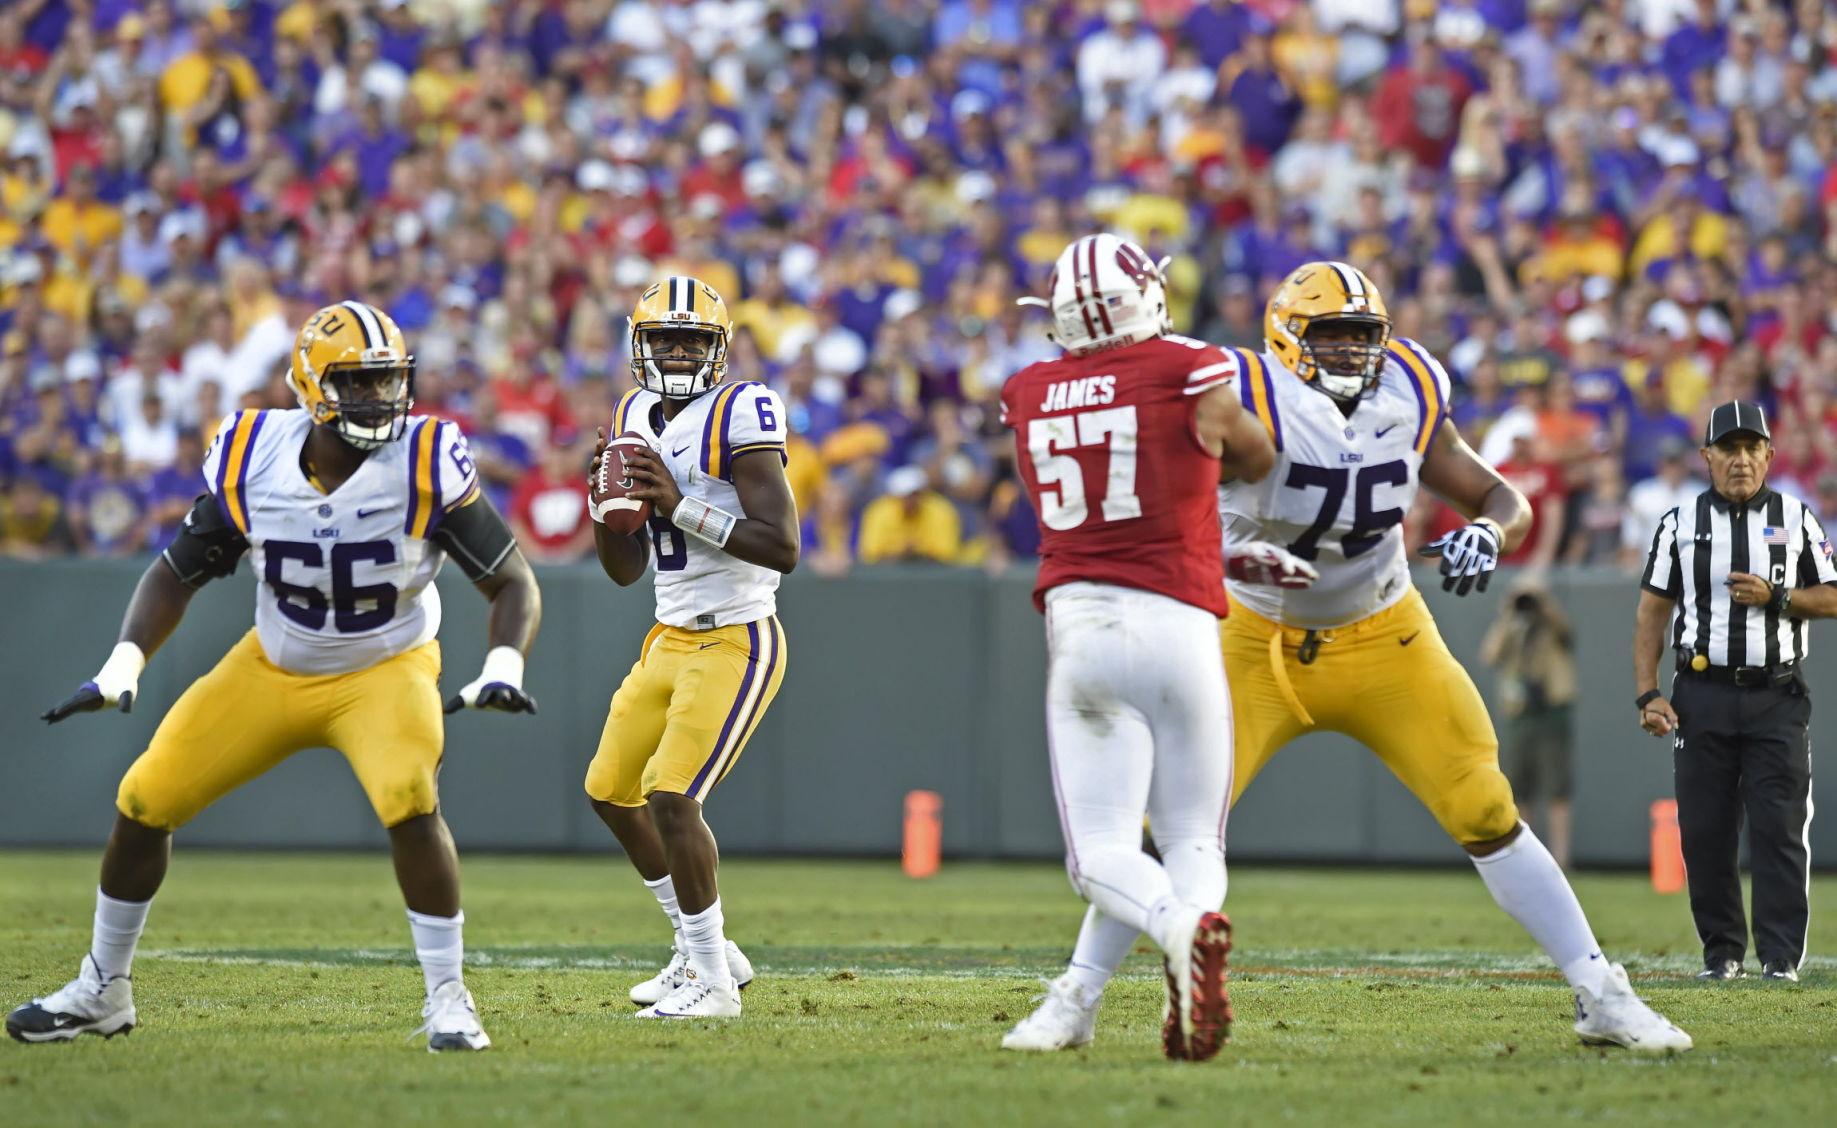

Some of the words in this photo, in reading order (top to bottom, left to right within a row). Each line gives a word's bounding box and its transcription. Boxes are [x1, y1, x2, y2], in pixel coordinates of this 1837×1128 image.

[1040, 375, 1116, 412] JAMES
[755, 396, 777, 431] 6
[1028, 405, 1143, 531] 57
[1340, 452, 1364, 463] LSU
[1285, 459, 1408, 562] 76
[312, 528, 340, 539] LSU
[262, 539, 398, 633] 66
[1771, 563, 1785, 585] C
